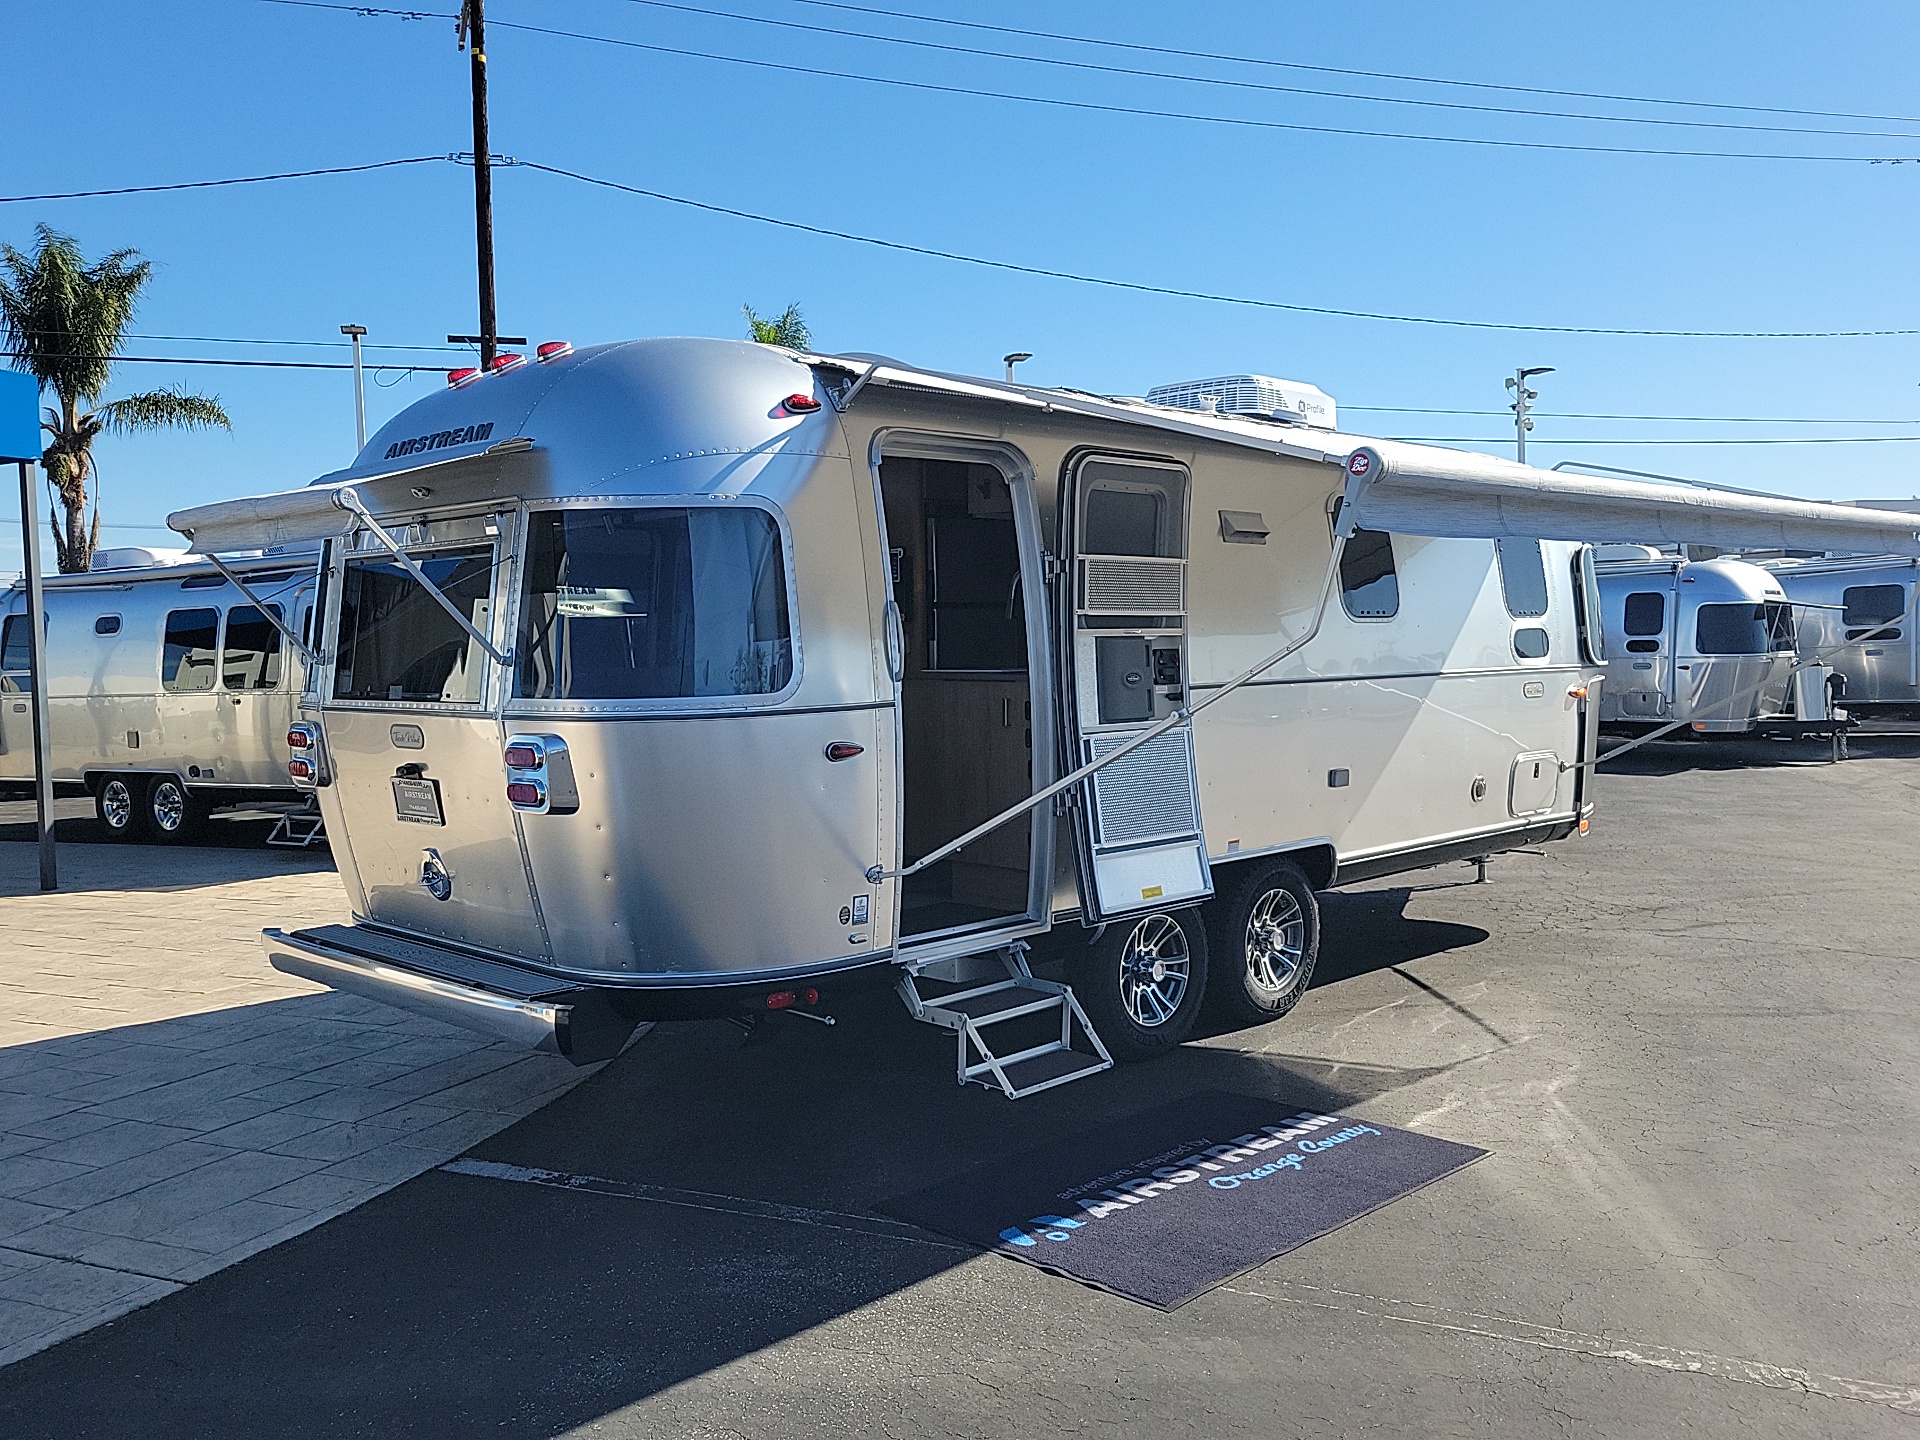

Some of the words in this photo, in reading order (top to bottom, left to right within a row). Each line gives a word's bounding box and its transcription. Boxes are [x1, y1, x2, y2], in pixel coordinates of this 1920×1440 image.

[1306, 403, 1325, 415] Profile
[383, 422, 494, 460] AIRSTREAM
[1354, 456, 1368, 466] Zip
[404, 790, 433, 801] AIRSTREAM
[1075, 1110, 1340, 1219] AIRSTREAM
[1131, 1144, 1193, 1169] inspired
[1207, 1153, 1307, 1190] Orange
[1297, 1123, 1384, 1154] County
